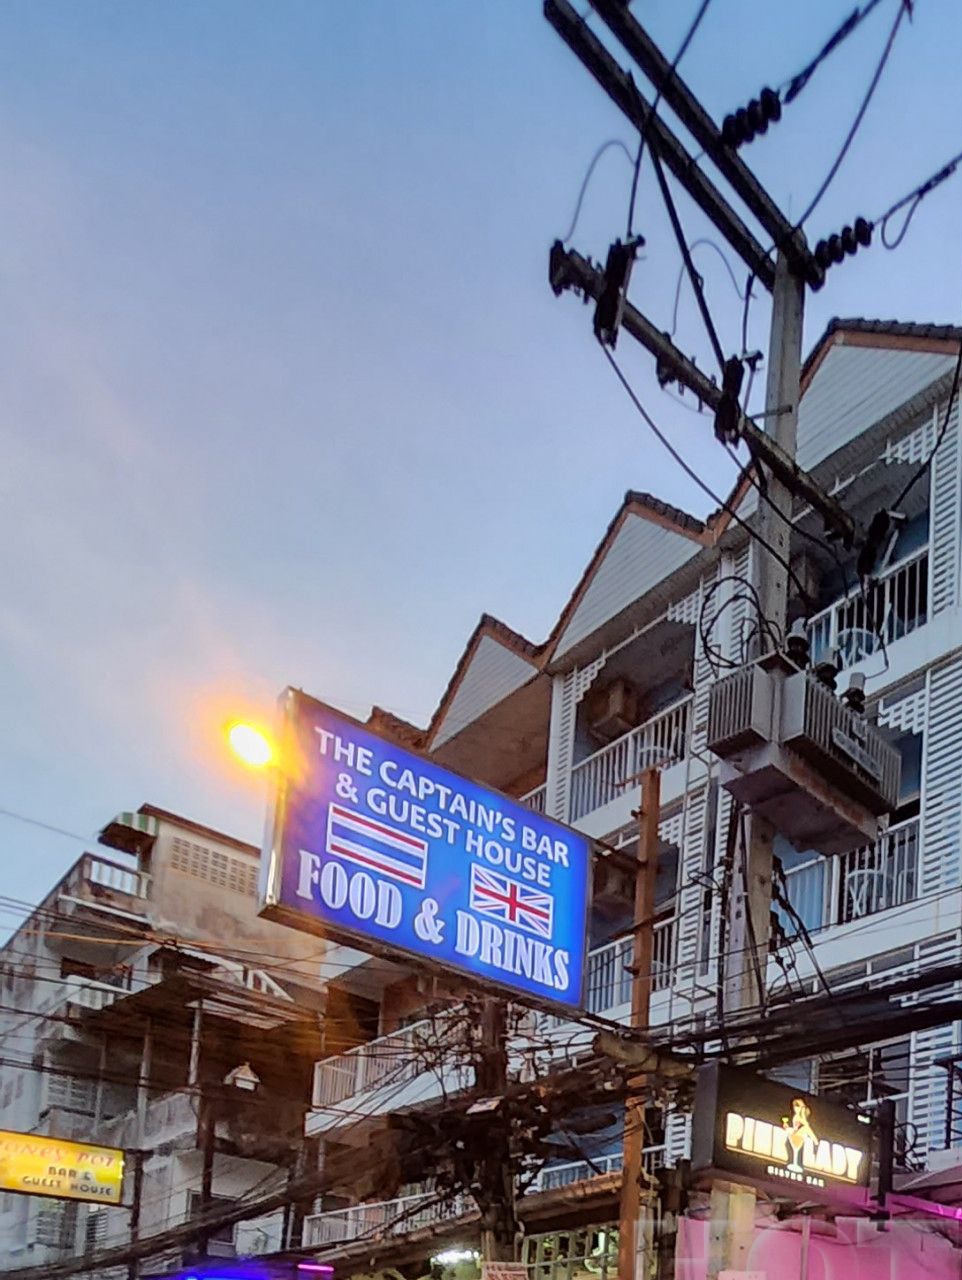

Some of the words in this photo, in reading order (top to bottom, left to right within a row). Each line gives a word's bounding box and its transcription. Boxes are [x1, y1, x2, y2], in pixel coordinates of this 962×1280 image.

[315, 726, 374, 776] THE
[379, 760, 517, 843] CAPTAIN'S
[521, 826, 570, 868] BAR
[335, 772, 359, 803] &
[367, 788, 461, 845] GUEST
[465, 834, 552, 888] HOUSE
[296, 850, 403, 930] FOOD
[413, 898, 446, 945] &
[454, 910, 570, 992] DRINKS
[22, 1175, 61, 1188] GUEST
[70, 1183, 112, 1197] HOUSE
[48, 1165, 77, 1179] BAR
[726, 1111, 790, 1163] PINK
[802, 1135, 863, 1181] LADY
